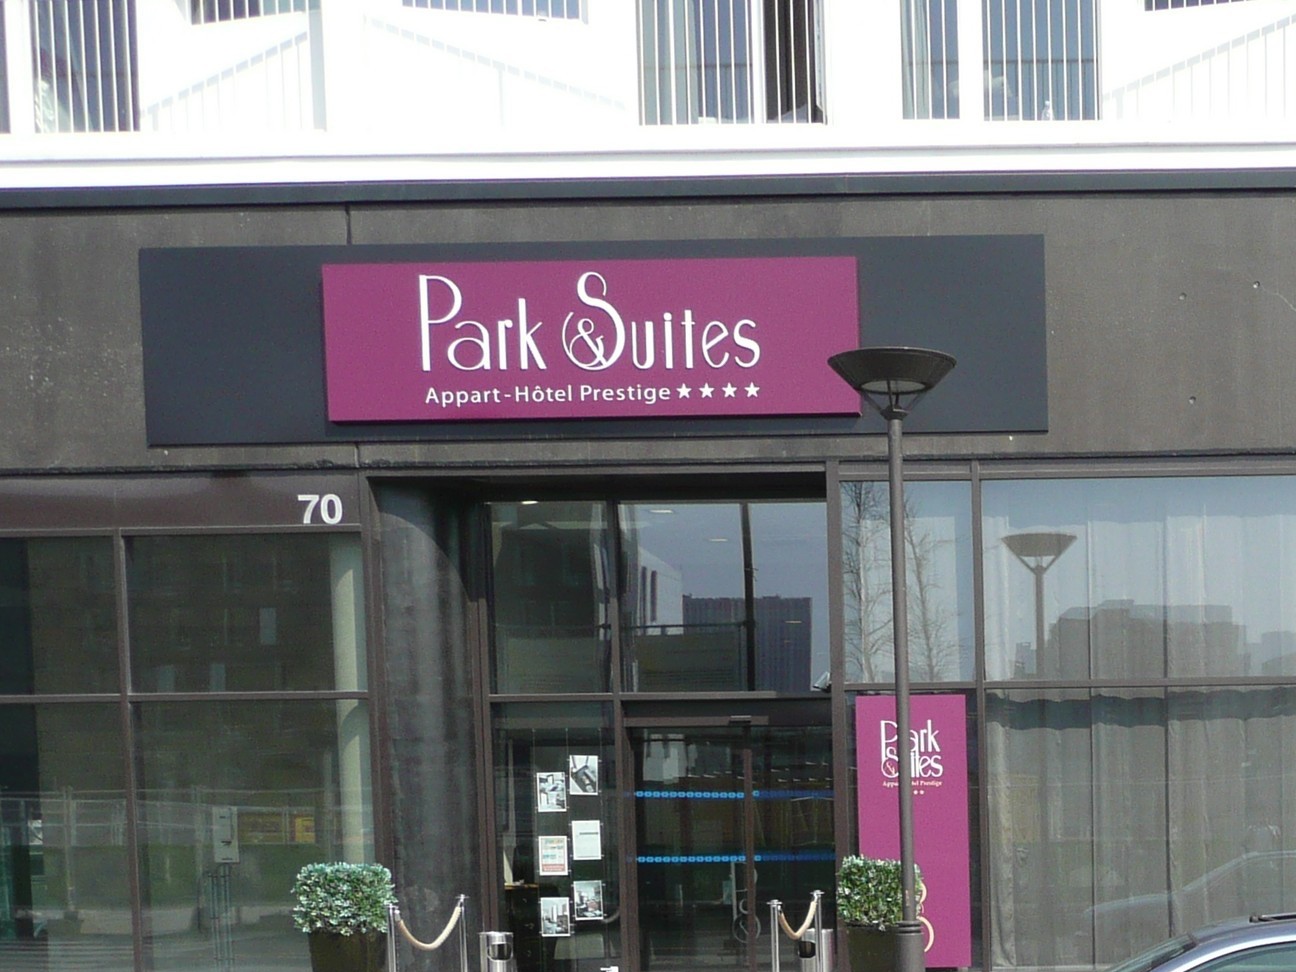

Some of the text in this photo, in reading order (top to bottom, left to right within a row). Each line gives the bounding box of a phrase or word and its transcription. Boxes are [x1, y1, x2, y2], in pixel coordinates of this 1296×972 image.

[418, 274, 547, 371] Park
[580, 384, 671, 404] Prestige
[297, 493, 343, 525] 70
